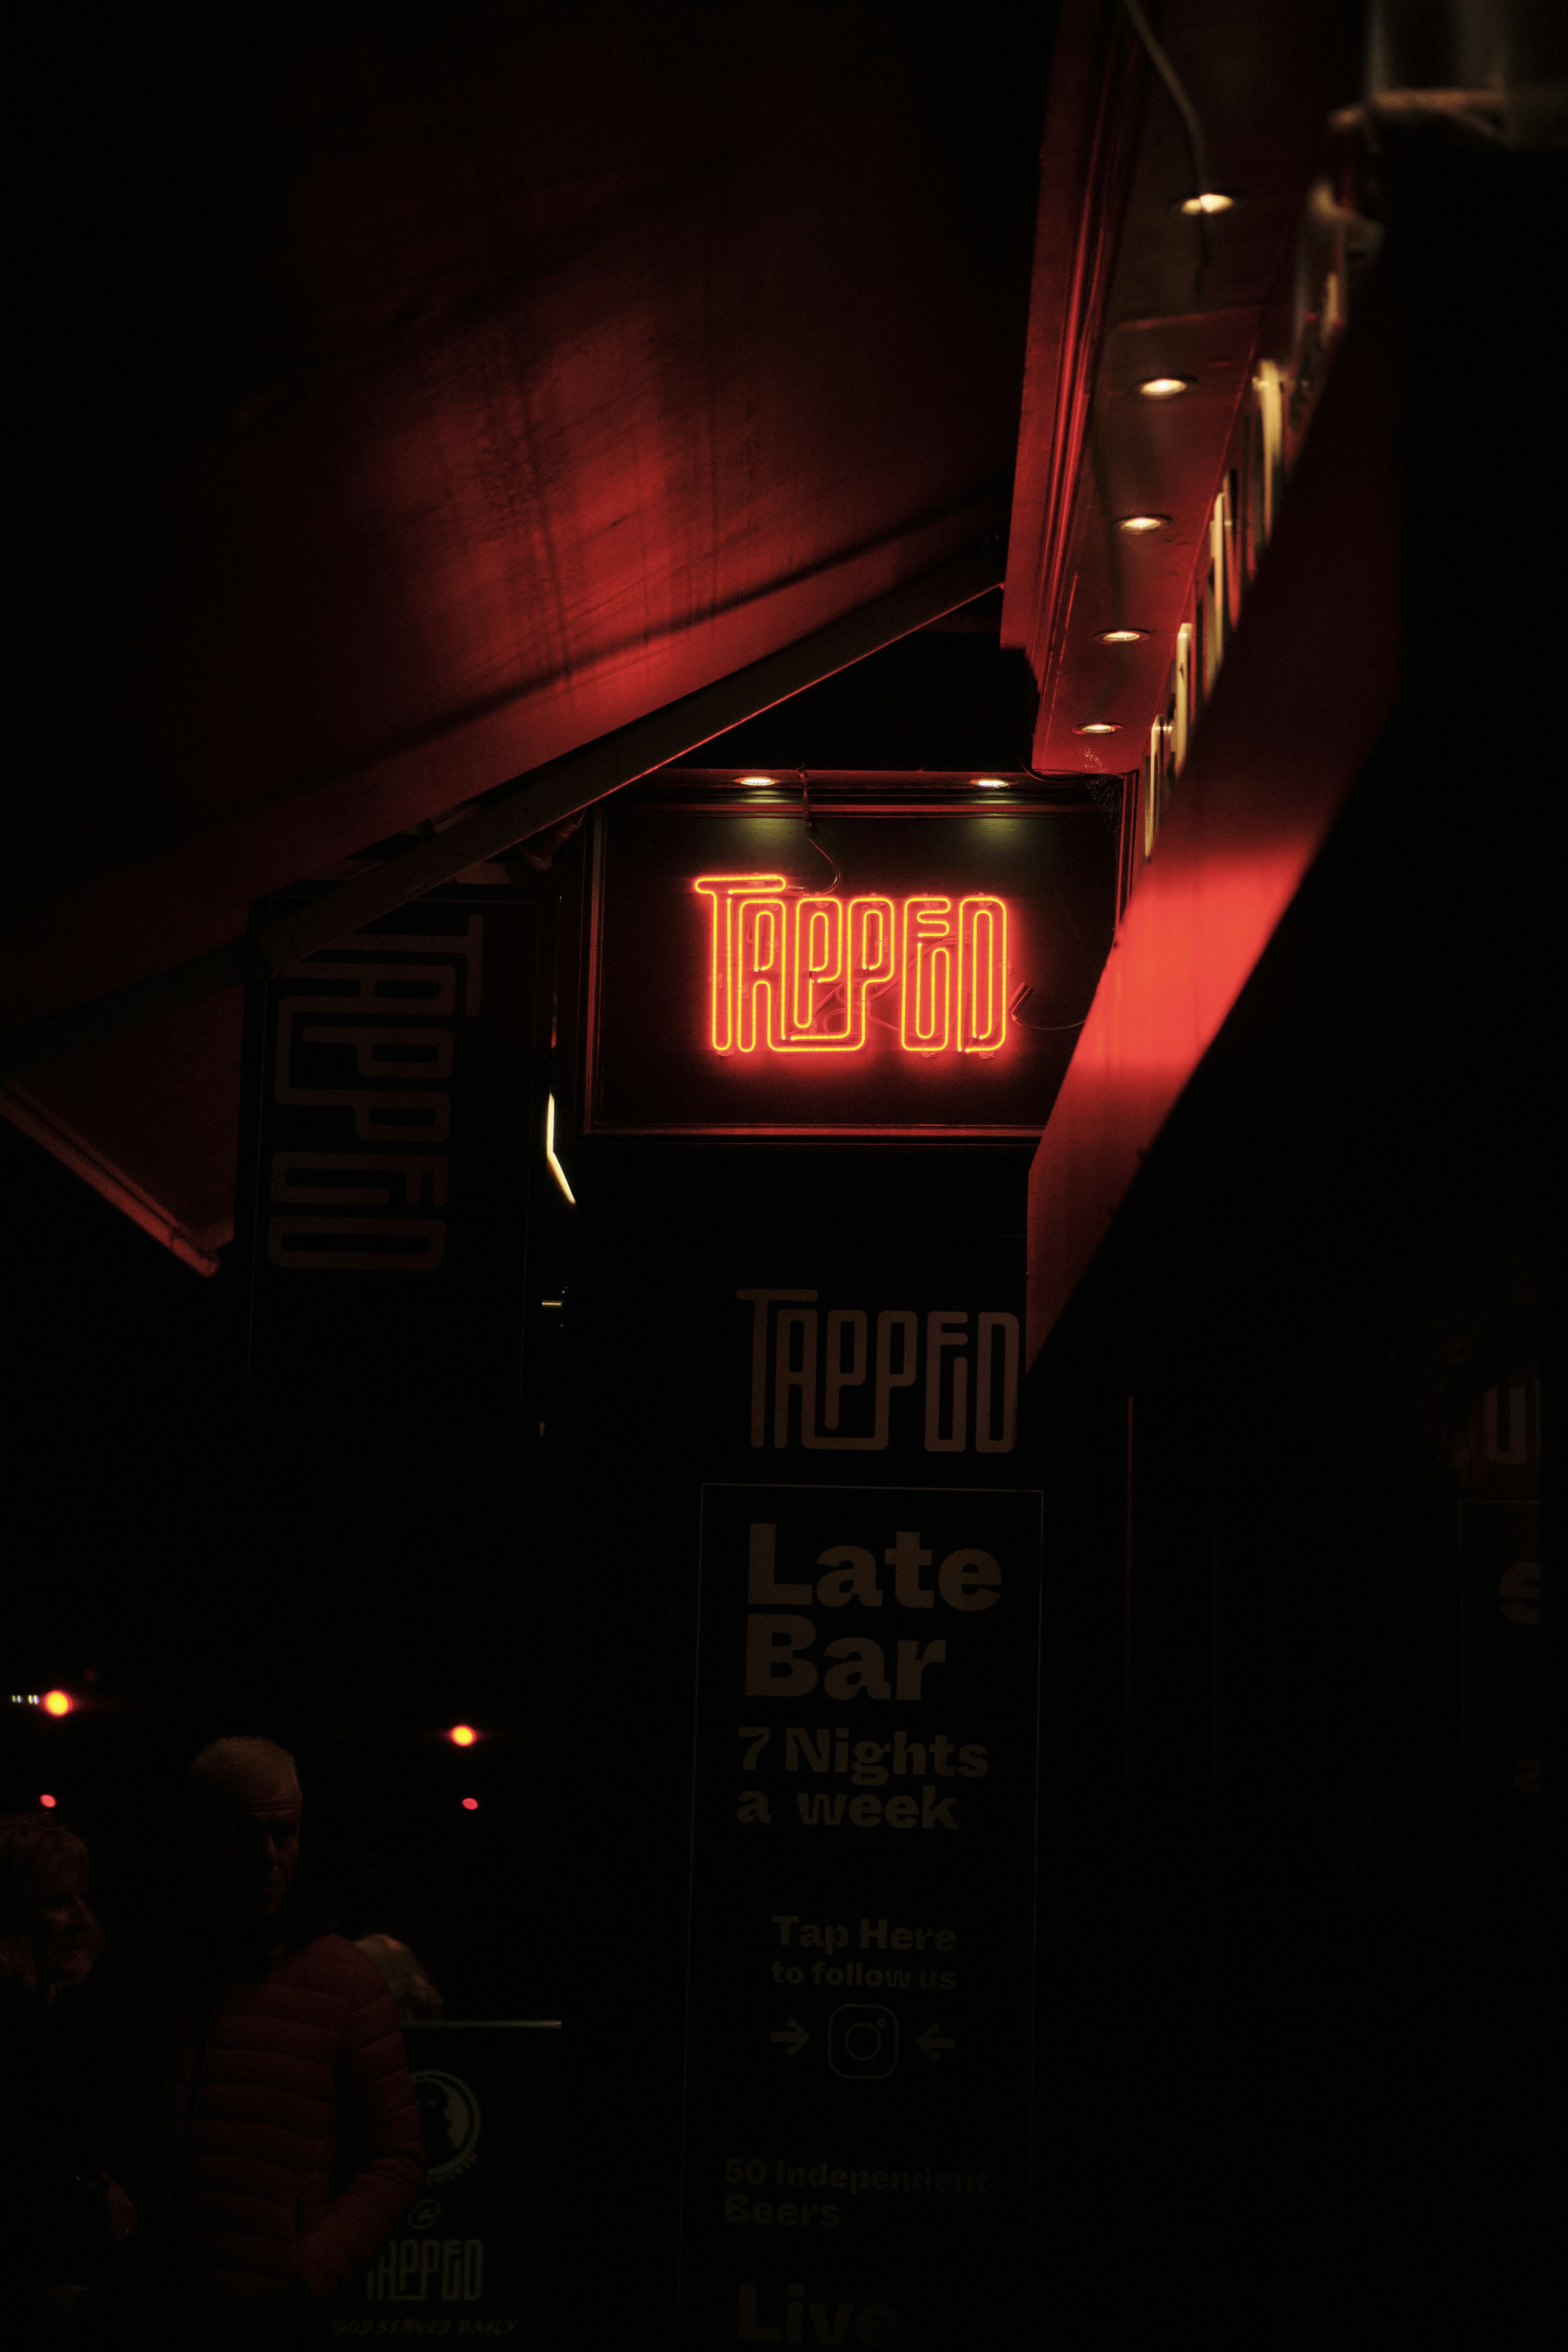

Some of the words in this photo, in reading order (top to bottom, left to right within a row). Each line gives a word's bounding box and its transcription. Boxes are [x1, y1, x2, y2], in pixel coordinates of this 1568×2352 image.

[694, 874, 1008, 1053] TAPPED
[735, 1288, 1020, 1454] TAPPED
[747, 1522, 1003, 1612] Late
[745, 1612, 947, 1701] Bar
[737, 1725, 772, 1771] 7
[784, 1726, 989, 1787] Nights
[735, 1789, 772, 1825] a
[796, 1784, 960, 1830] week
[771, 1914, 850, 1956] Tap
[859, 1917, 957, 1952] Here
[770, 1960, 805, 1985] to
[810, 1960, 913, 1989] follow
[919, 1970, 957, 1991] us
[724, 2157, 768, 2185] 50
[775, 2159, 989, 2196] Independent
[724, 2192, 841, 2228] Beers
[737, 2282, 898, 2347] Live
